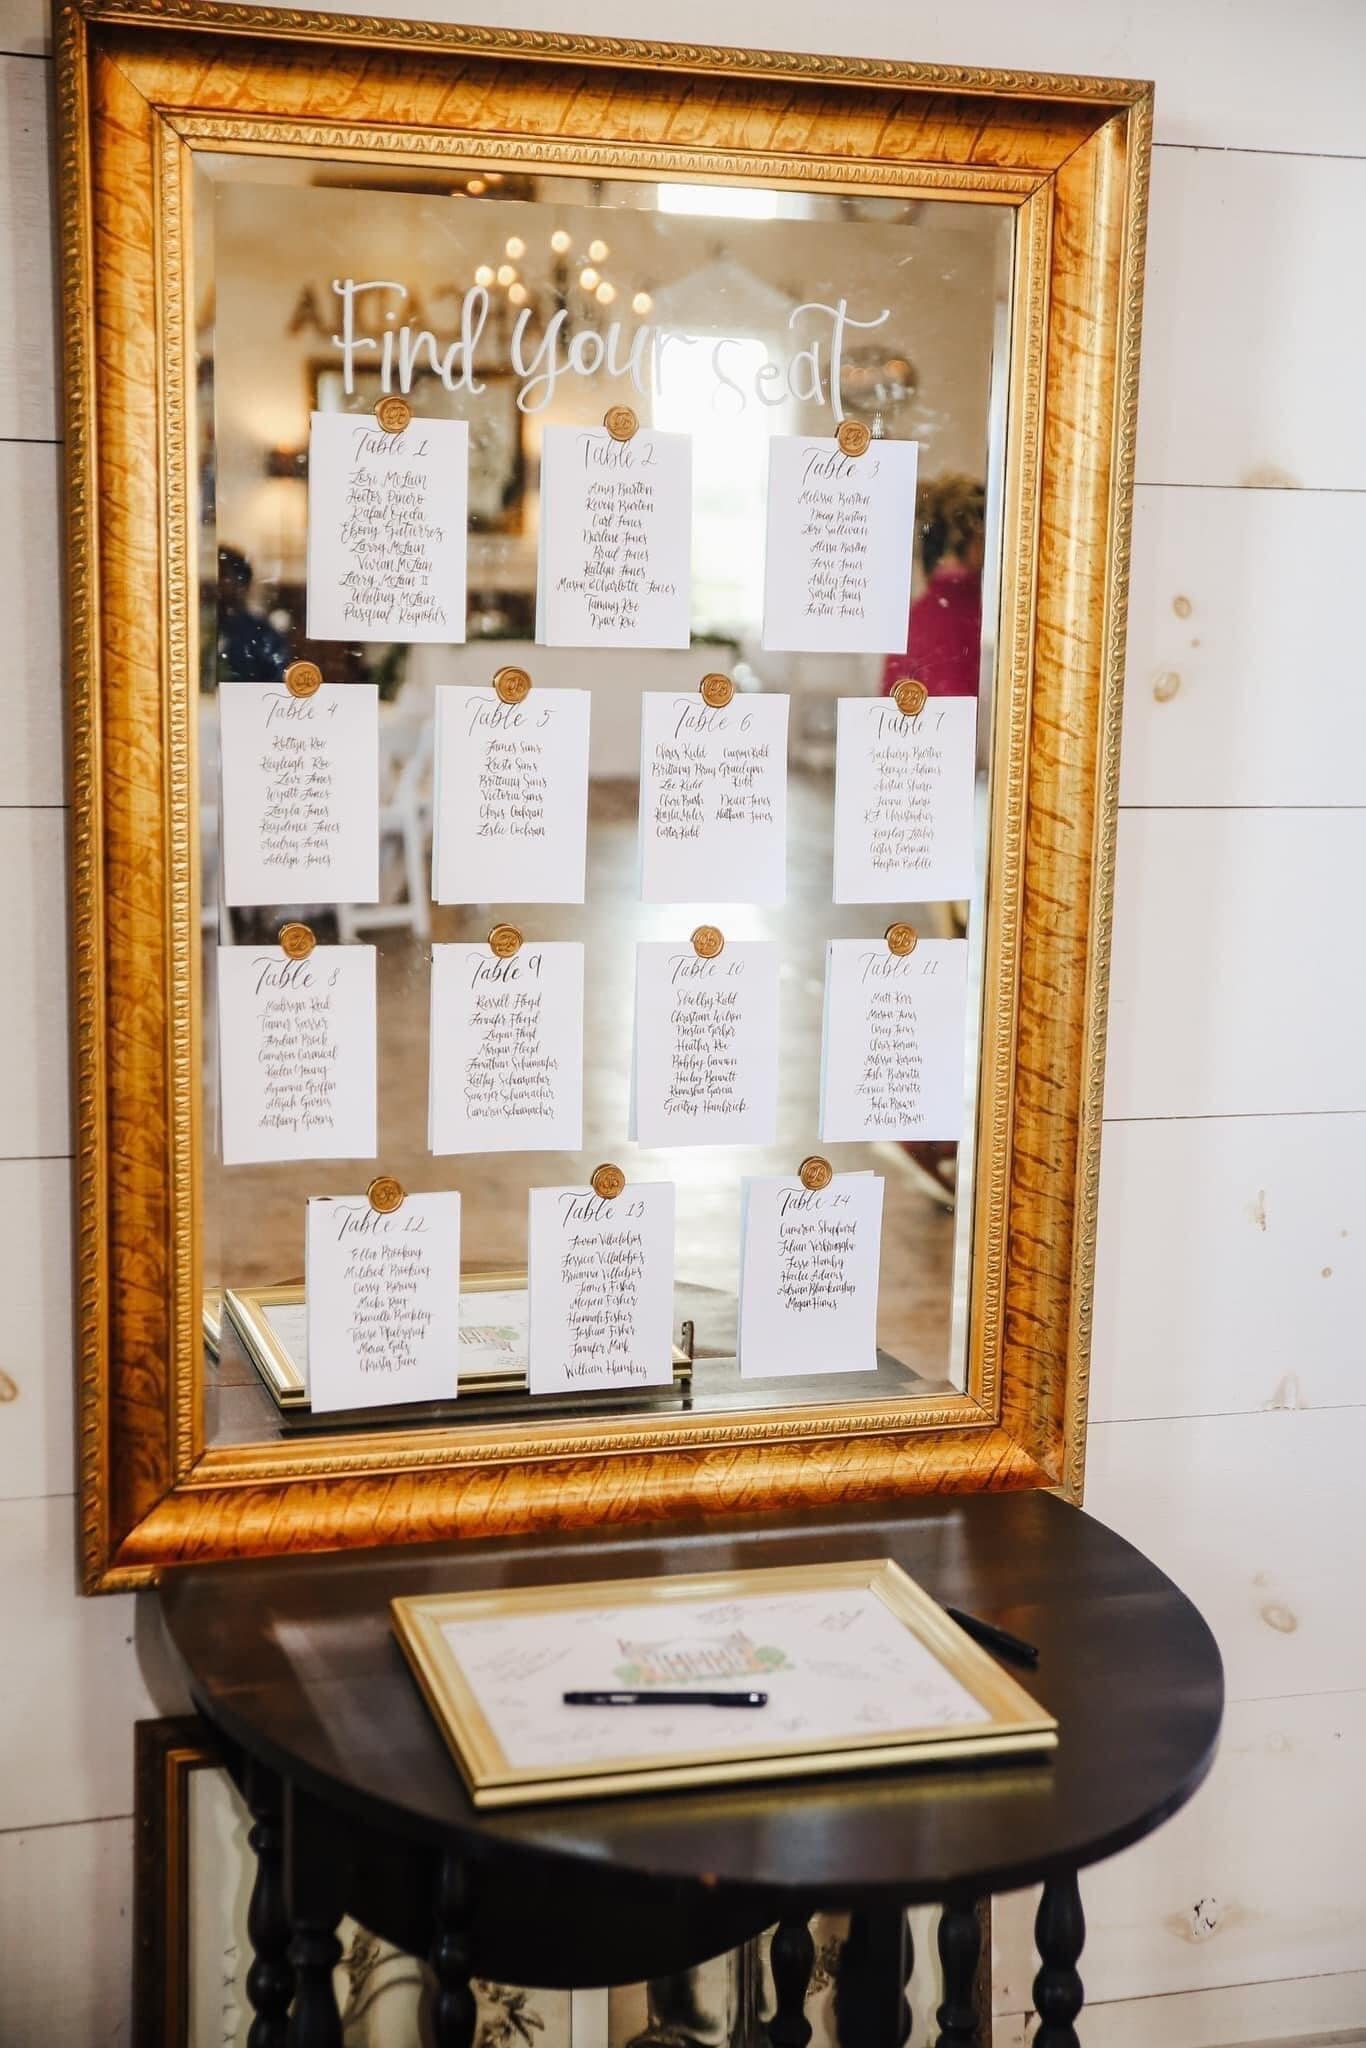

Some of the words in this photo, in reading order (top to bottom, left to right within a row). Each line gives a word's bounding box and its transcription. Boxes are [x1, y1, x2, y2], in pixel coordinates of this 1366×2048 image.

[331, 280, 489, 395] Find
[352, 426, 405, 463] Table
[576, 433, 632, 472] Table
[641, 442, 660, 466] 2
[802, 447, 858, 486] Table
[262, 692, 316, 729] Table
[327, 702, 339, 718] 4
[465, 696, 529, 736] Table
[536, 709, 558, 728] 5
[673, 698, 728, 739] Table
[740, 712, 755, 732] 6
[869, 705, 924, 740] Table
[251, 956, 315, 995] Table
[465, 952, 521, 989] Table
[528, 953, 543, 979] 9
[668, 955, 718, 984] Table
[857, 952, 913, 985] Table
[558, 1190, 615, 1228] Table
[624, 1200, 646, 1219] 13
[777, 1187, 828, 1217] Table
[333, 1205, 394, 1241] Table
[401, 1215, 430, 1233] 12
